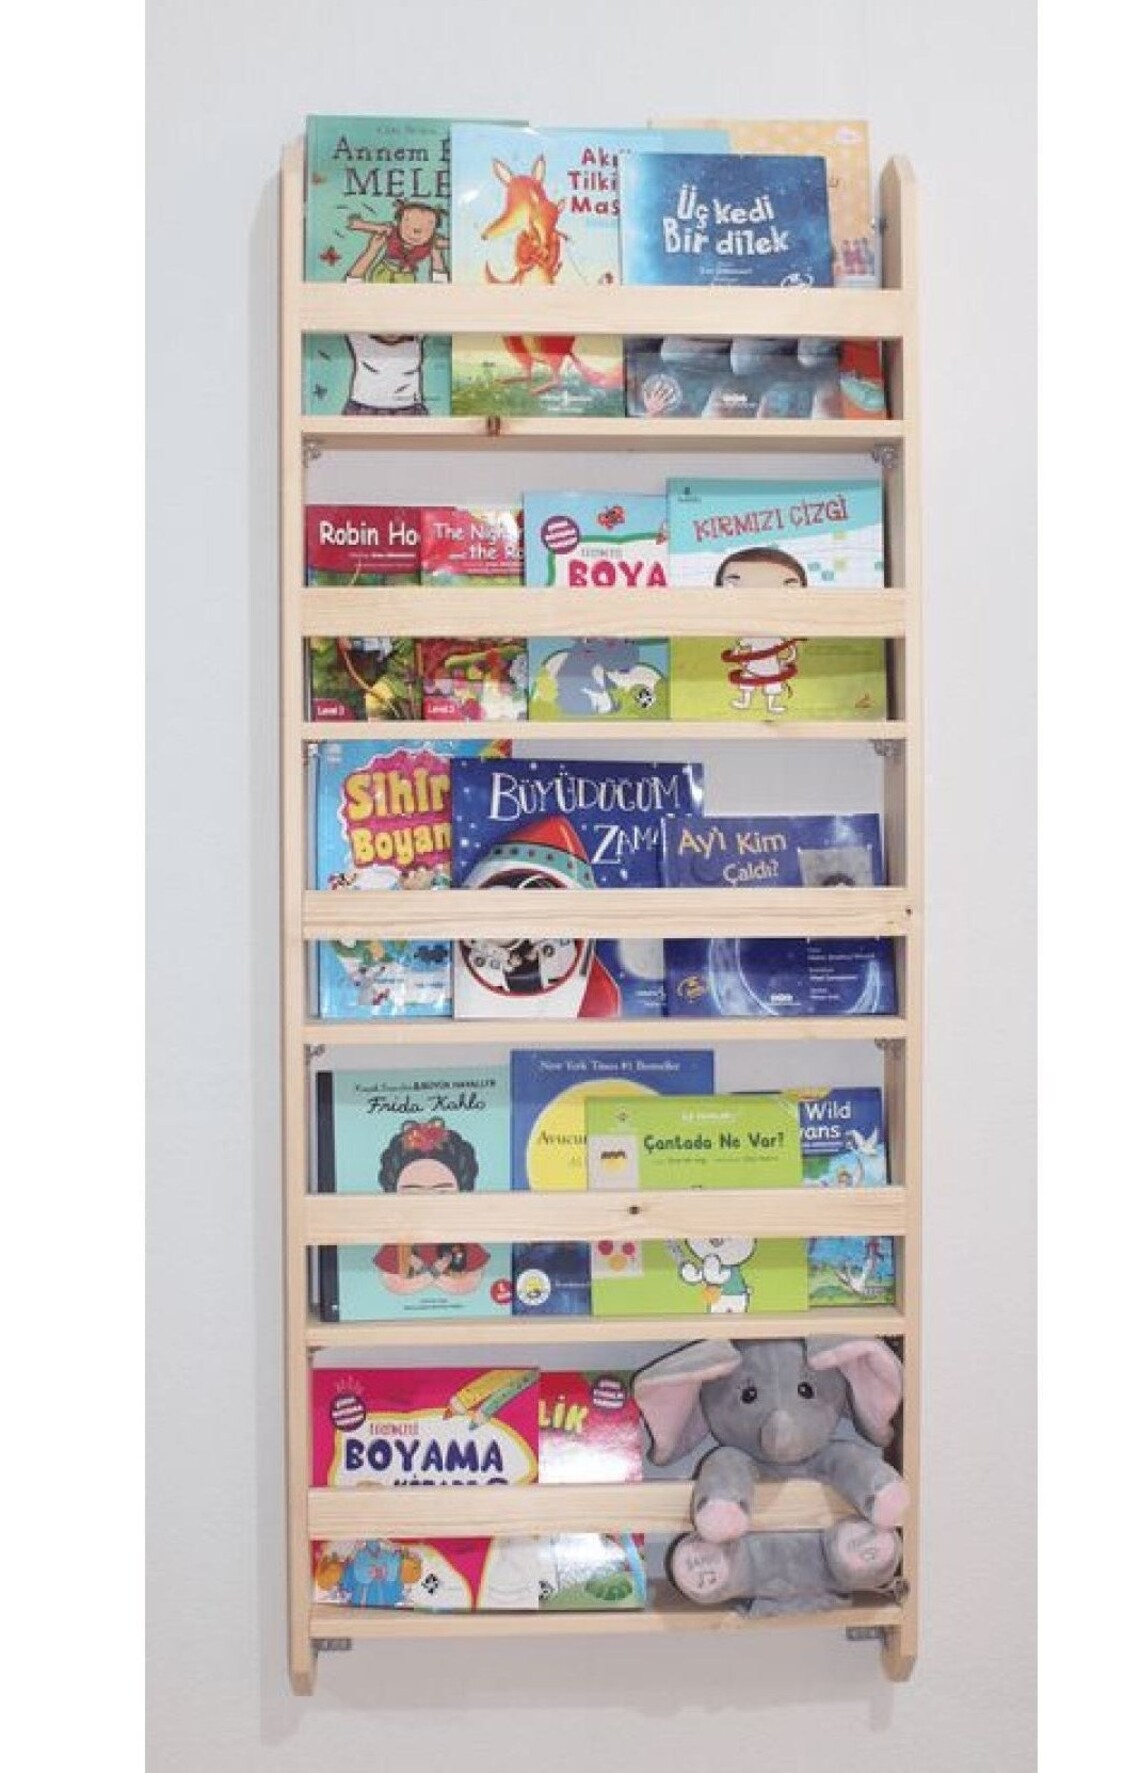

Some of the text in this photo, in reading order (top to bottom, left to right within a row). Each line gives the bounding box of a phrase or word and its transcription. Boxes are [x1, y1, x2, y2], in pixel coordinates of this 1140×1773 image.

[331, 134, 430, 162] Annem
[677, 184, 775, 229] Üç kedi
[662, 216, 789, 256] Bir dilek
[320, 520, 379, 546] Robin
[469, 543, 497, 560] the
[568, 560, 667, 587] BOYA
[736, 832, 787, 855] Kim
[367, 1091, 487, 1114] Frida Kahlo
[805, 1100, 851, 1120] Wild
[644, 1132, 784, 1155] Çantada Ne Var?
[345, 1438, 503, 1472] BOYAMA
